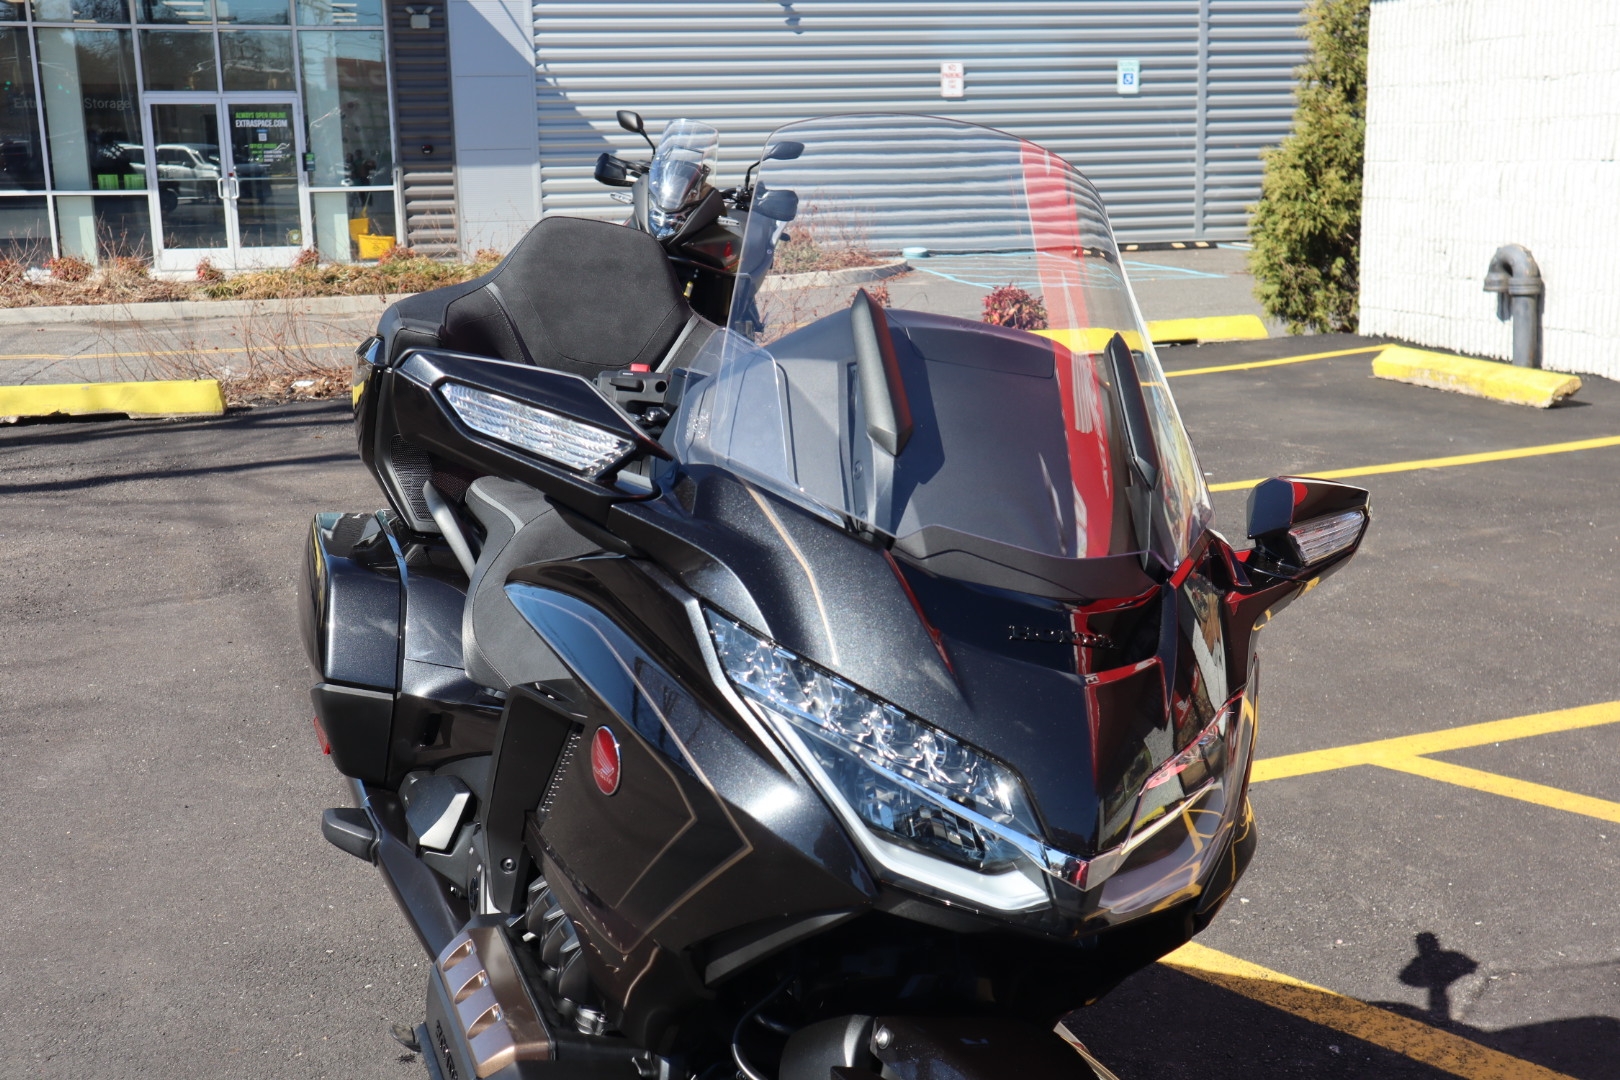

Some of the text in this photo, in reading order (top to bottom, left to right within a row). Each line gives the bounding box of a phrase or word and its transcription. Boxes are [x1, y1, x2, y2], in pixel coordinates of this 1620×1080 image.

[84, 97, 132, 110] Storage
[236, 120, 288, 128] EXTRASPACE.COM
[1008, 625, 1116, 648] HONDA
